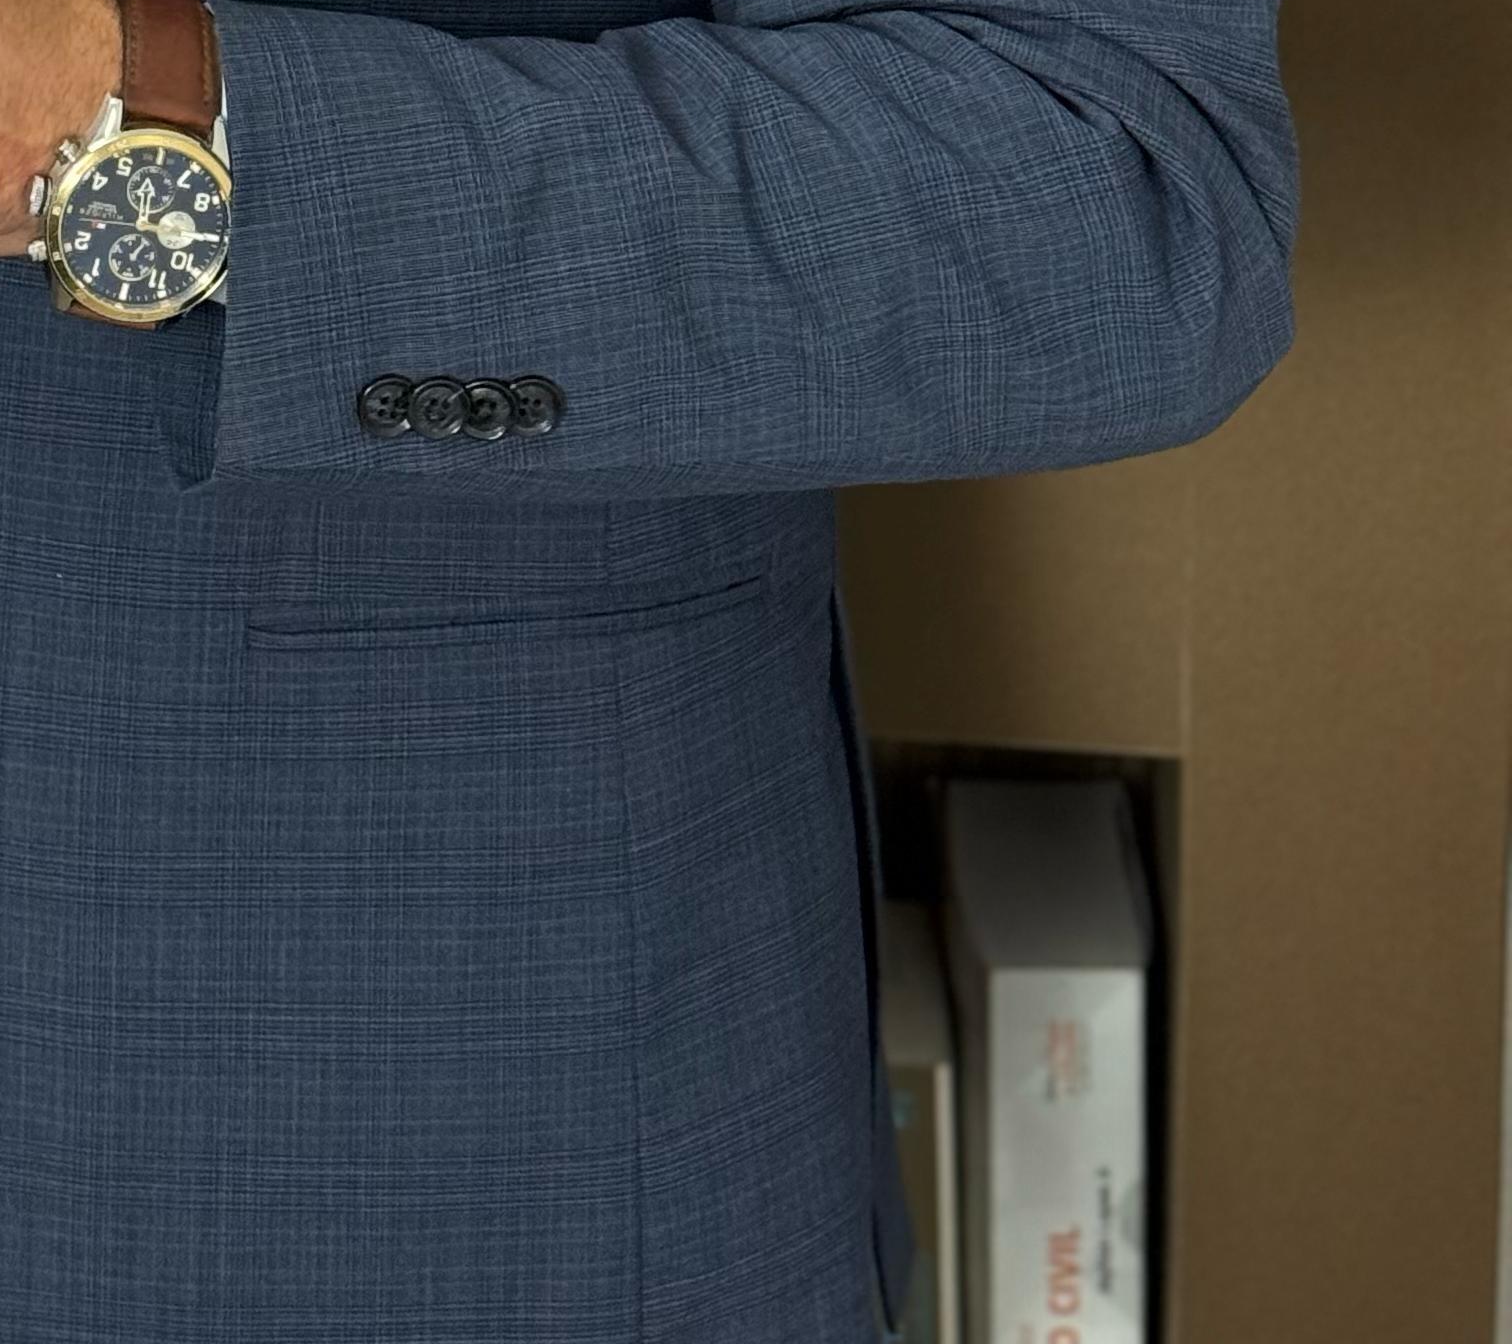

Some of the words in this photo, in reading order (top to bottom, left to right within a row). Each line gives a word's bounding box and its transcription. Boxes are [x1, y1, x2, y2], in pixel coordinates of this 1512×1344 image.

[116, 157, 134, 178] 5
[91, 171, 109, 192] 4
[177, 169, 193, 189] 7
[193, 192, 211, 212] 8
[74, 230, 92, 251] 2
[170, 250, 194, 272] 10
[148, 268, 167, 290] 11
